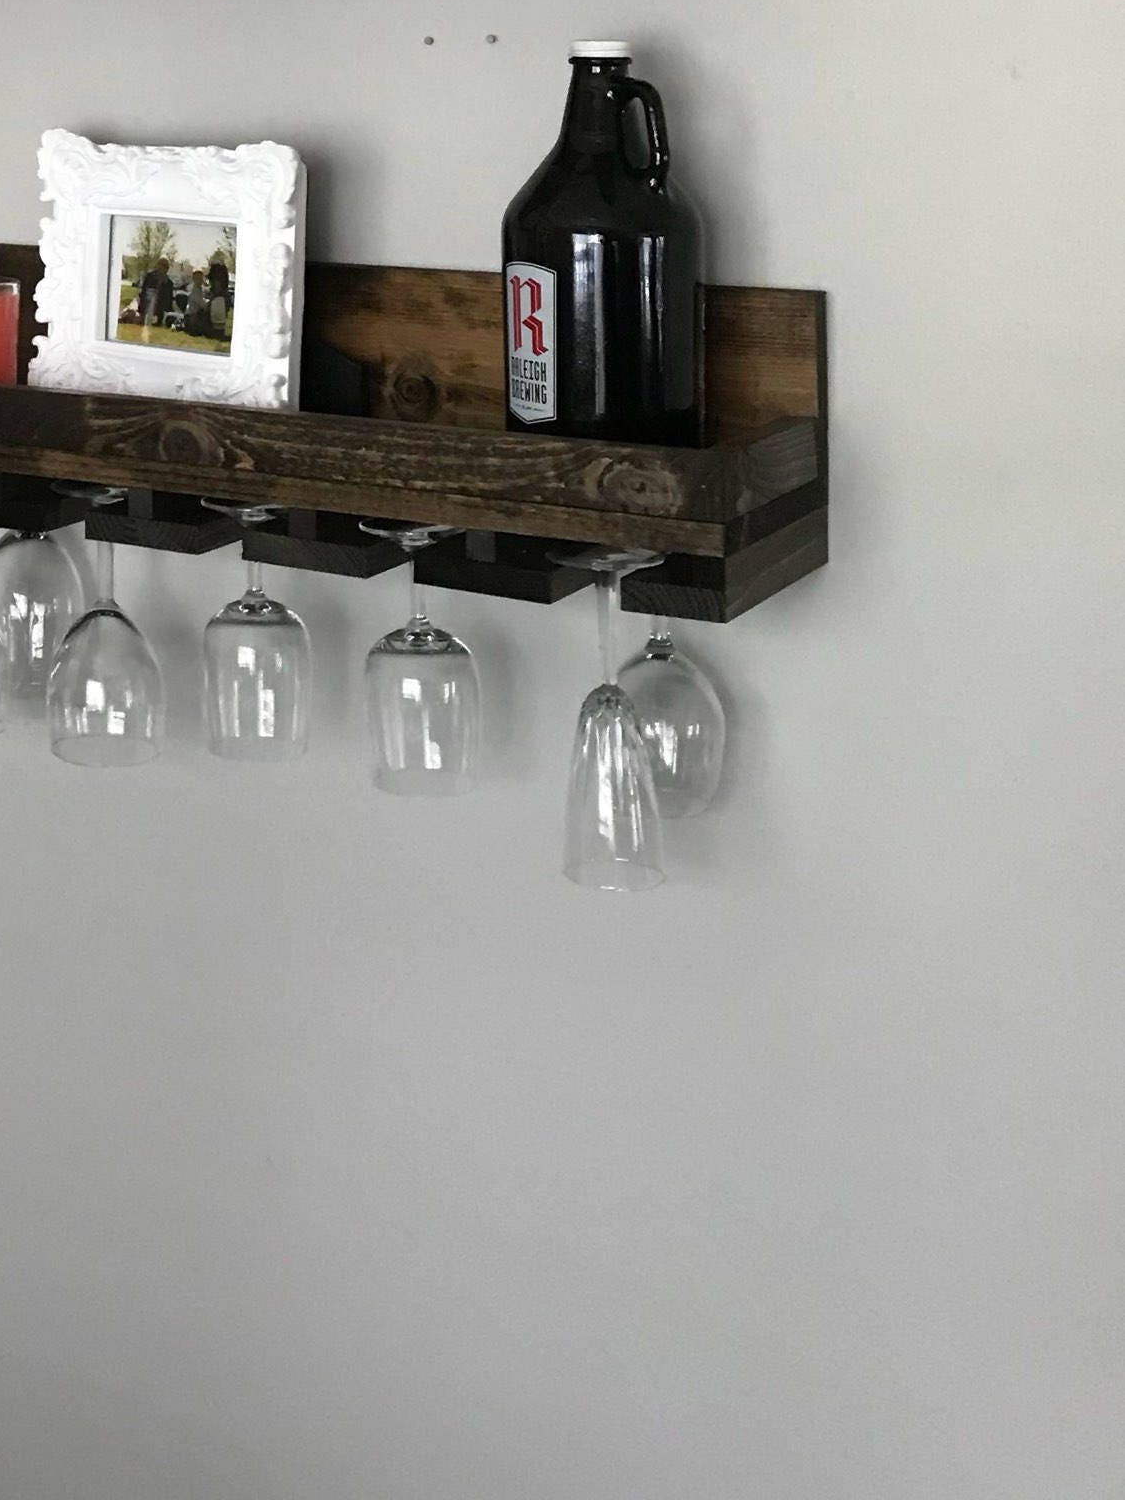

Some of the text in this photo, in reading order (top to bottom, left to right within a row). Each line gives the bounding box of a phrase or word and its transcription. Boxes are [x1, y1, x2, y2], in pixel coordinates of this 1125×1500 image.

[510, 275, 549, 357] R
[511, 356, 547, 383] RALEIGH
[511, 378, 548, 405] BREWING
